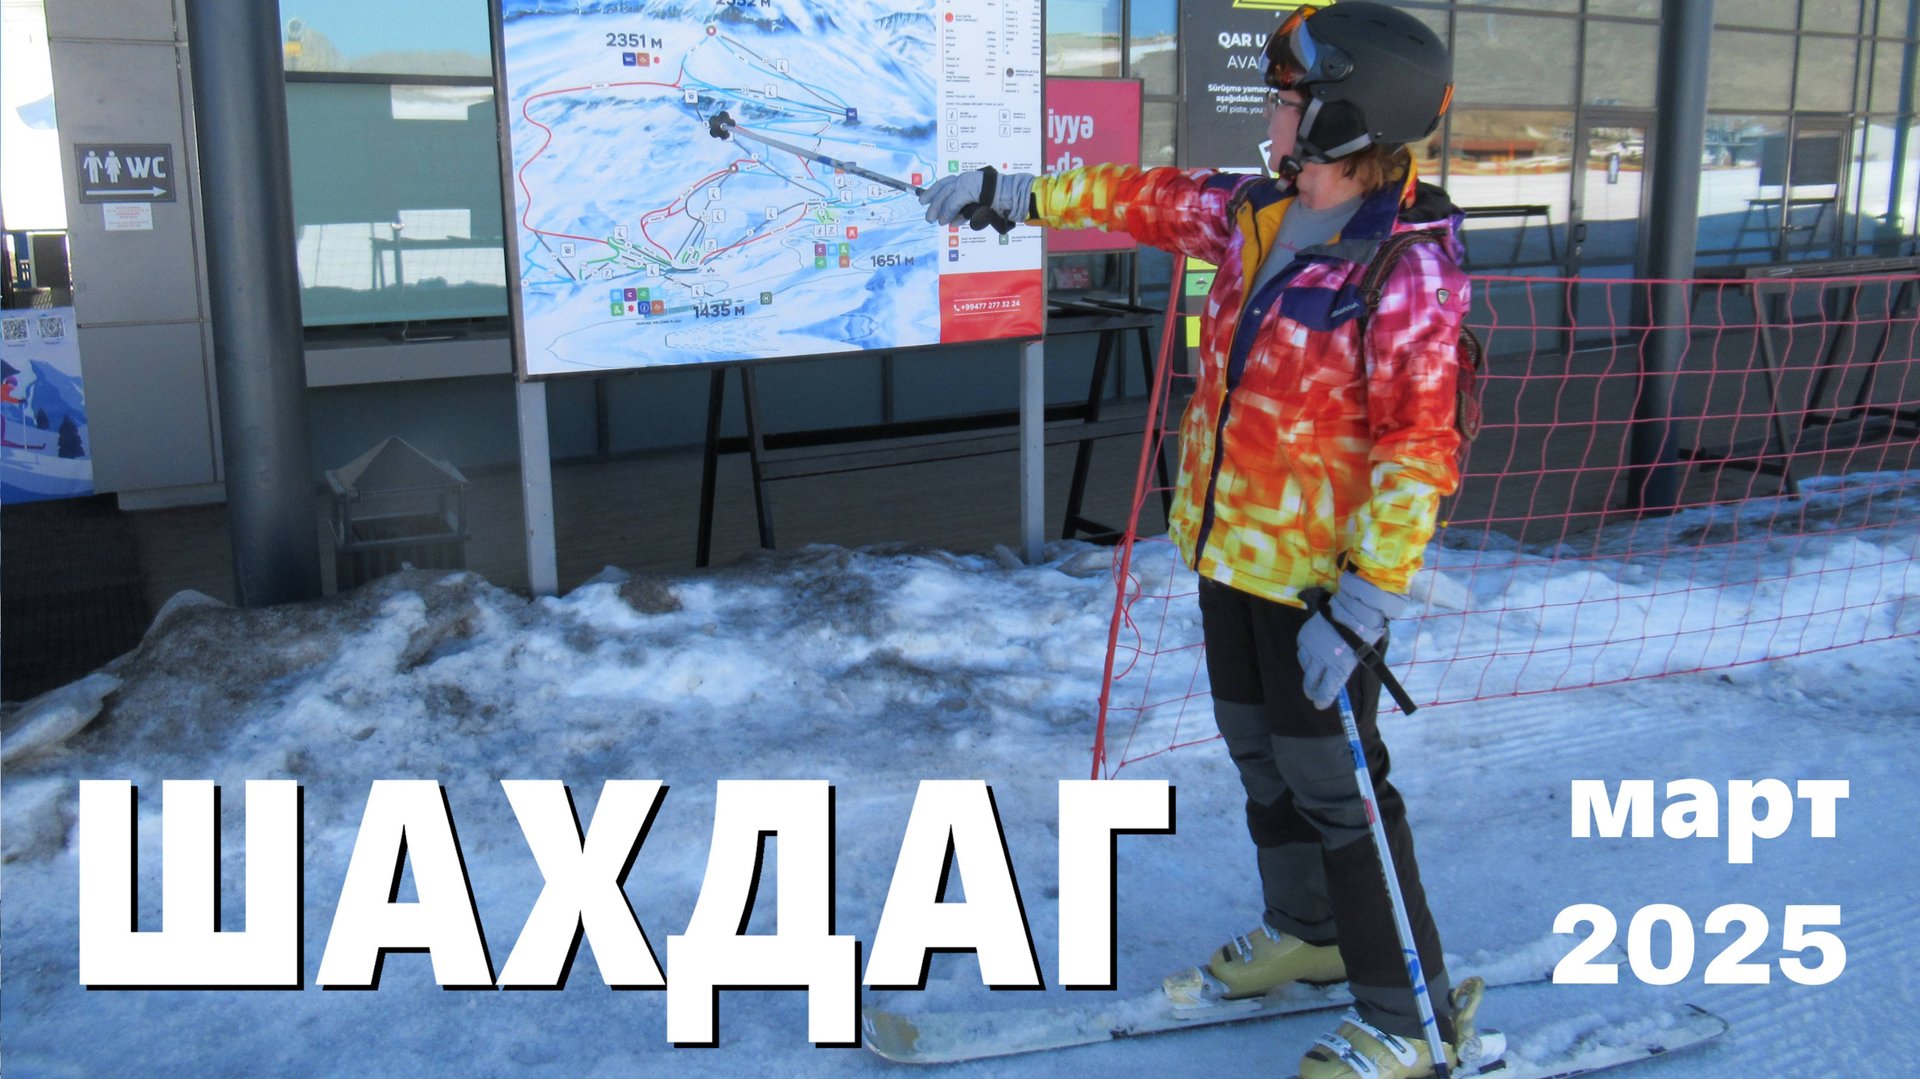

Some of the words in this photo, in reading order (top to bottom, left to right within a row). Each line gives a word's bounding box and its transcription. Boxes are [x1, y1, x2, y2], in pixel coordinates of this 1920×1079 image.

[606, 32, 646, 48] 2351
[651, 38, 663, 49] M
[1218, 32, 1252, 49] QAR
[1226, 55, 1260, 69] AVA
[1216, 105, 1229, 113] Off
[1047, 109, 1094, 144] iyyə
[125, 156, 167, 178] WC
[871, 254, 901, 268] 1651
[905, 257, 914, 266] M
[693, 304, 731, 319] 1435
[735, 306, 745, 316] M
[961, 302, 987, 311] +99477
[988, 301, 1001, 309] 277
[1002, 300, 1010, 308] 32
